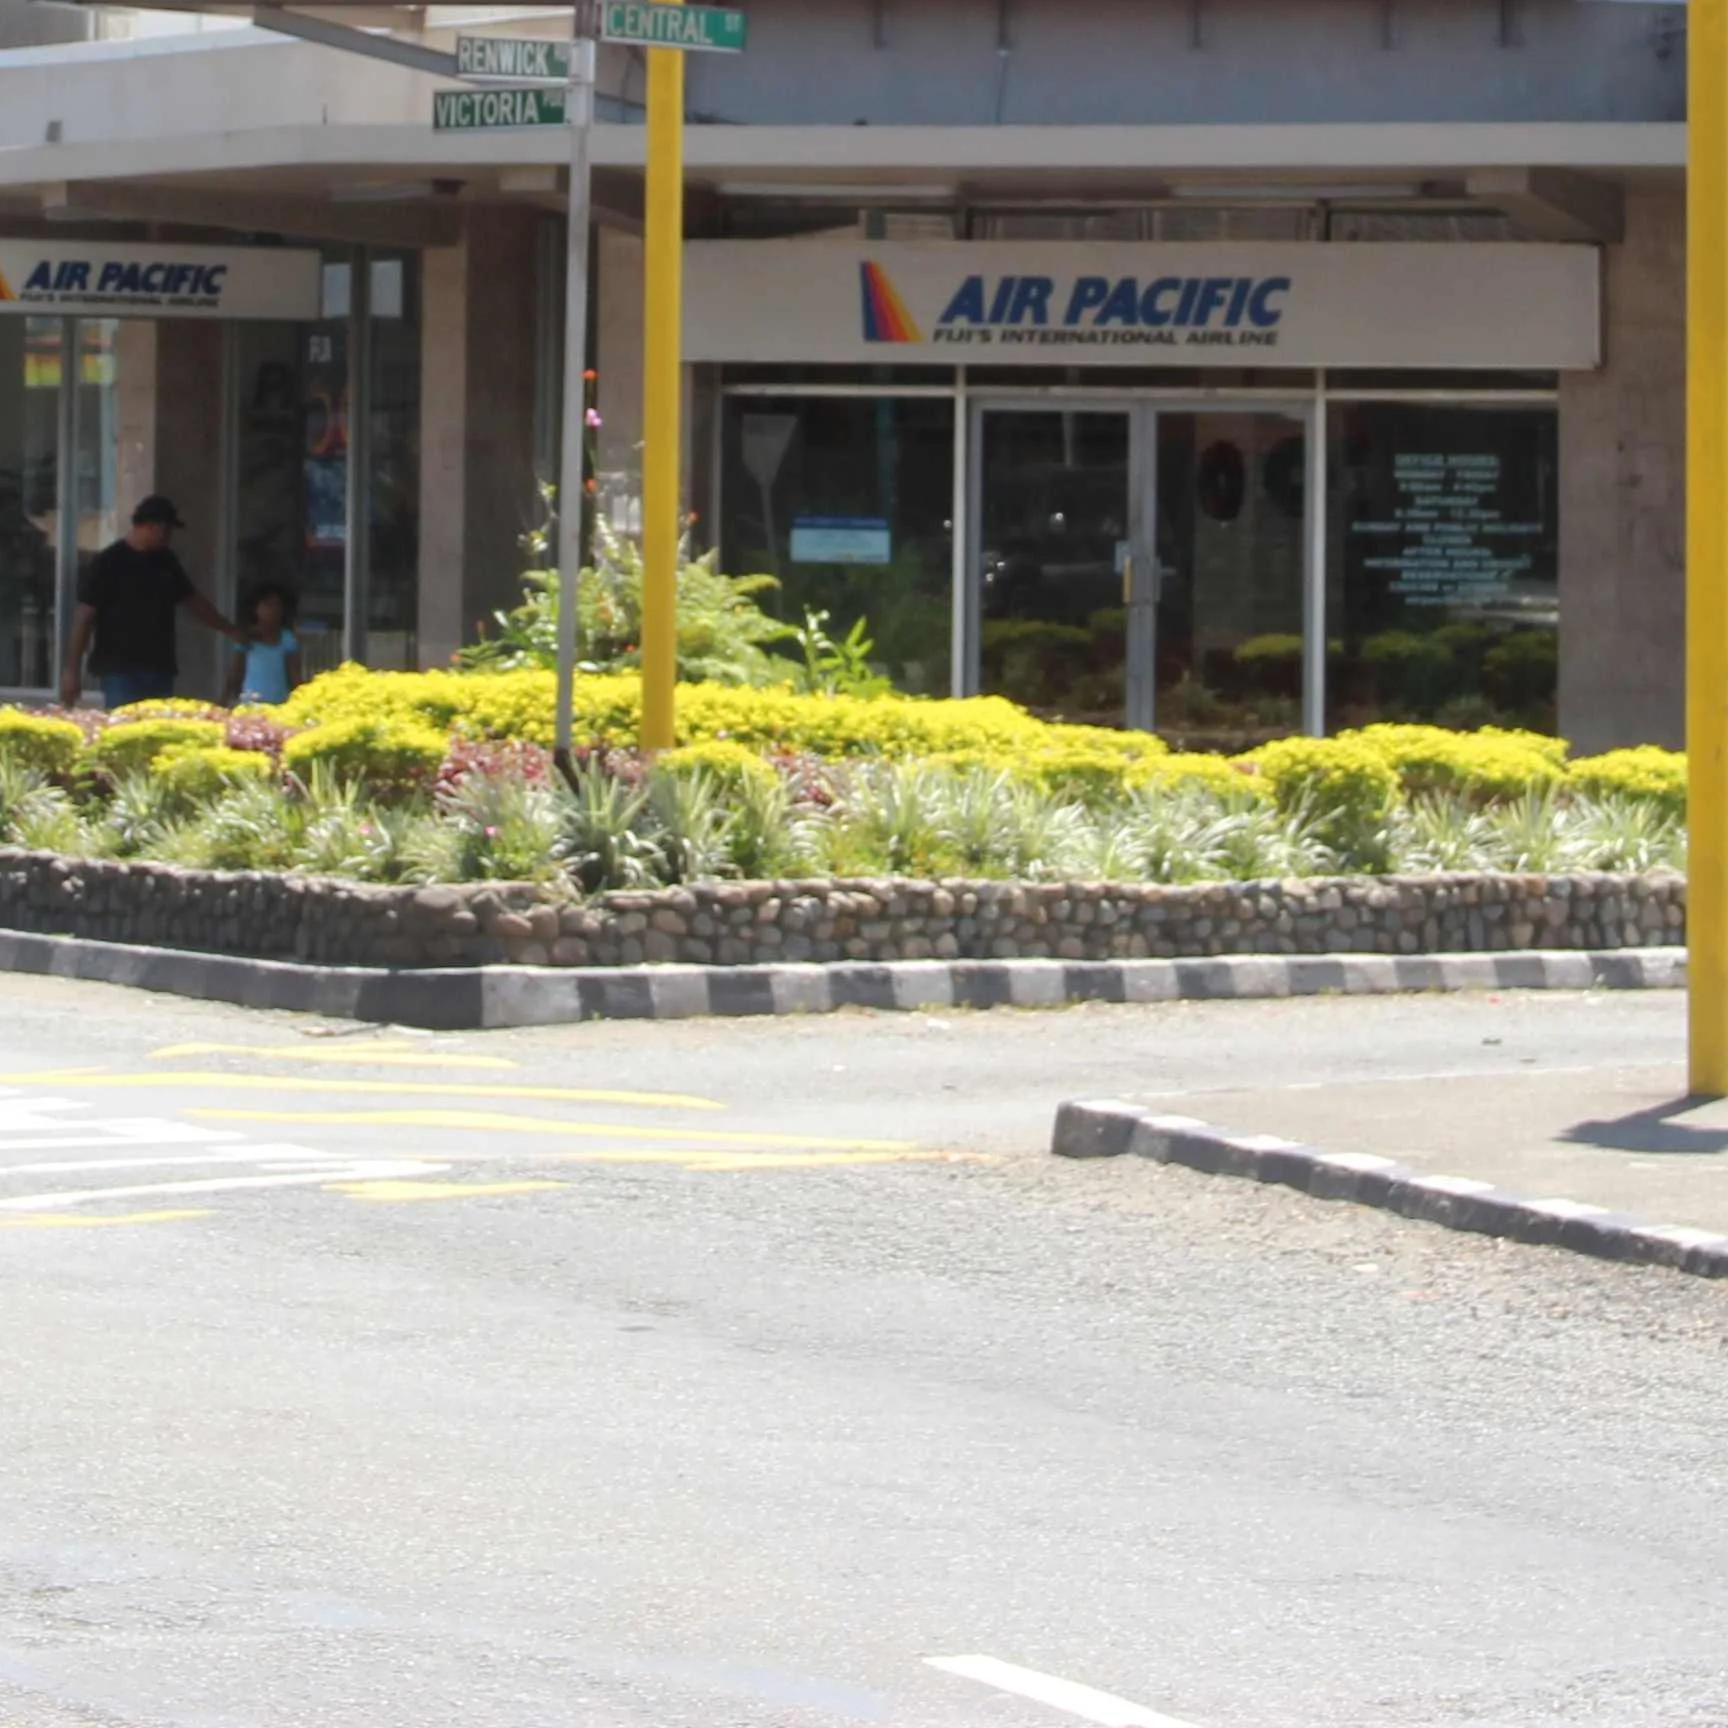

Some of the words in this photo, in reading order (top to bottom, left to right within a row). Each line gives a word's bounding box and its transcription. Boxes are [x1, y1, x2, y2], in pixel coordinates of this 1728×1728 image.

[608, 3, 714, 45] CENTRAL
[458, 39, 550, 76] RENWICK
[434, 90, 541, 129] VICTORIA
[23, 259, 91, 290] AIR
[96, 261, 228, 295] PACIFIC
[938, 275, 1054, 325] AIR
[1063, 276, 1291, 328] PACIFIC
[933, 328, 992, 343] FIJI'S
[1000, 329, 1180, 345] INTERNATIONAL
[1185, 331, 1278, 347] AIRLINE
